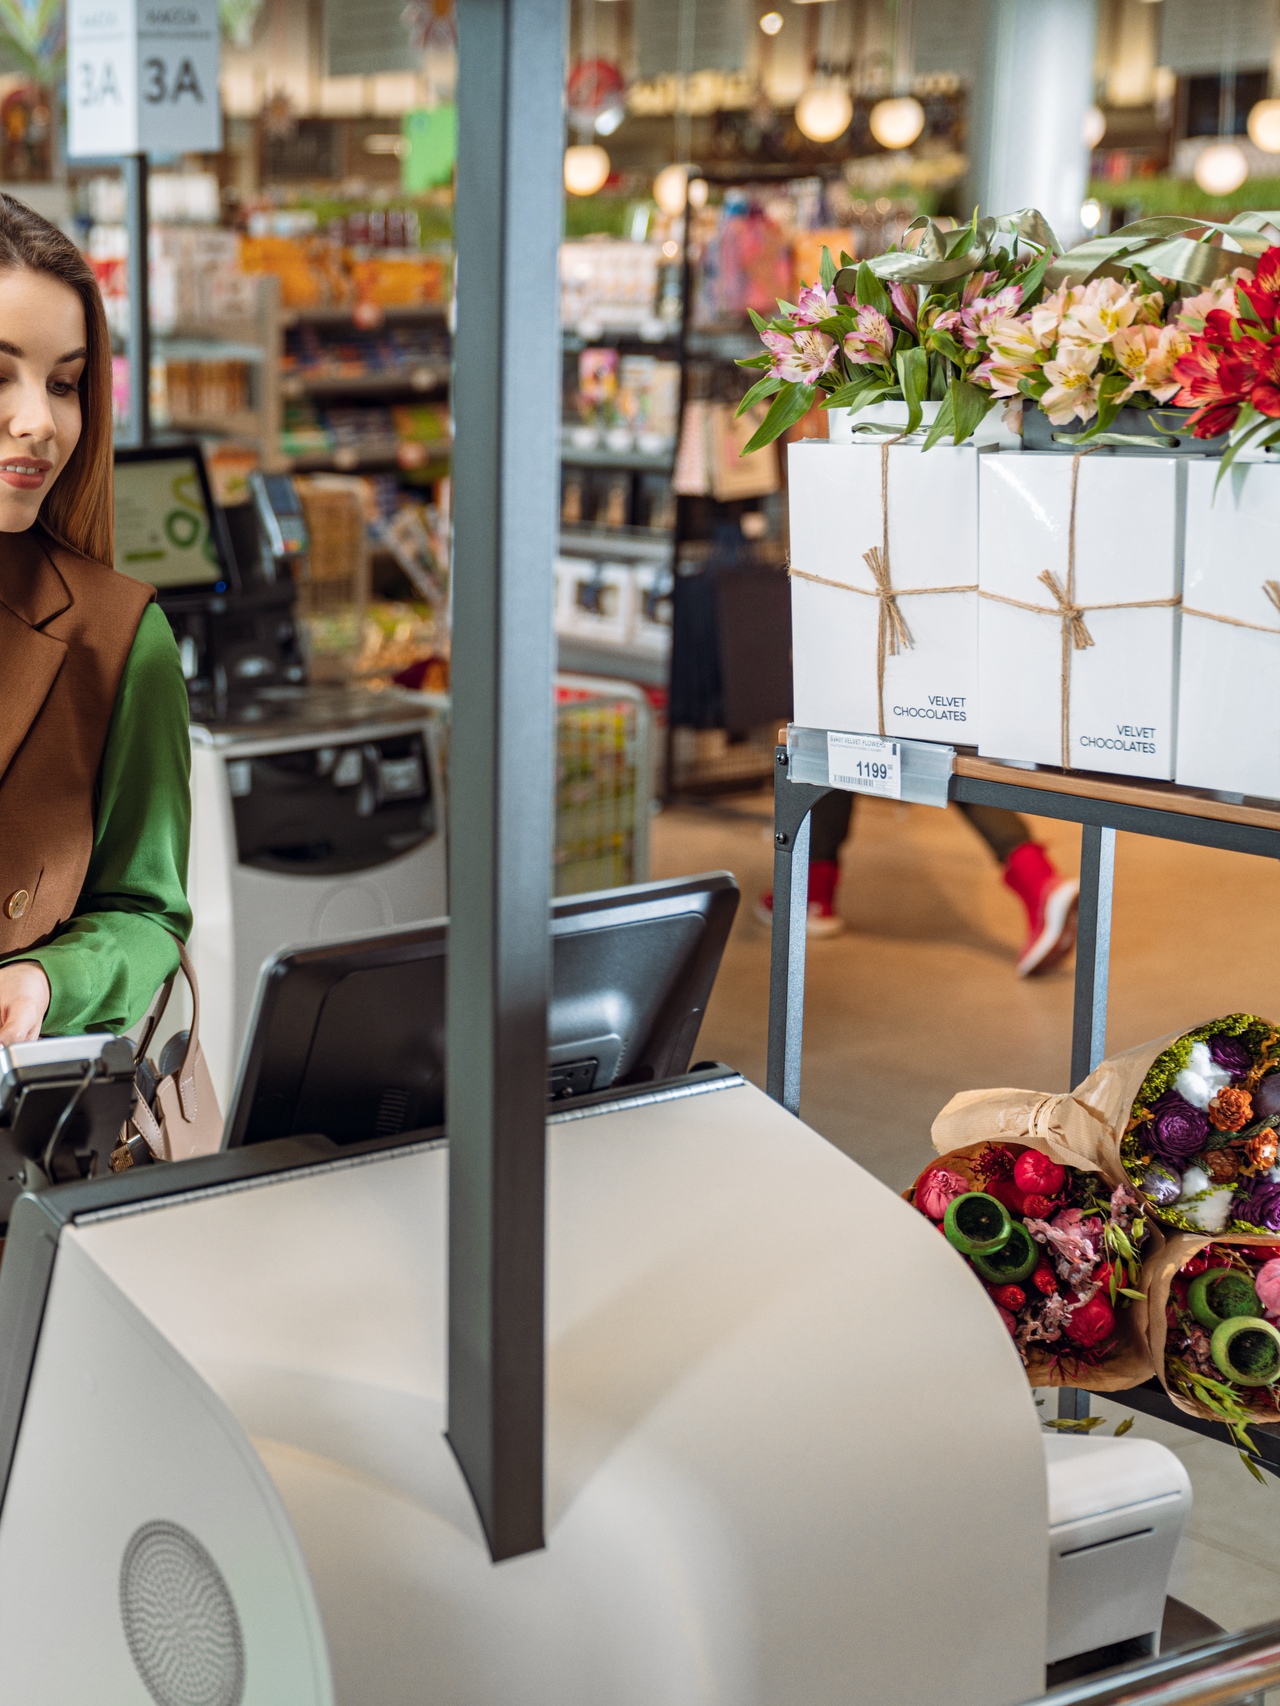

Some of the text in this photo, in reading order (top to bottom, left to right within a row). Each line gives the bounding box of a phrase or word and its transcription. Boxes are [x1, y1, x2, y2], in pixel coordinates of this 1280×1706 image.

[143, 56, 207, 106] 3A
[928, 695, 966, 708] VELVET
[893, 706, 967, 722] CHOCOLATES
[1116, 725, 1156, 739] VELVET
[1080, 736, 1156, 754] CHOCOLATES
[856, 760, 887, 779] 1199
